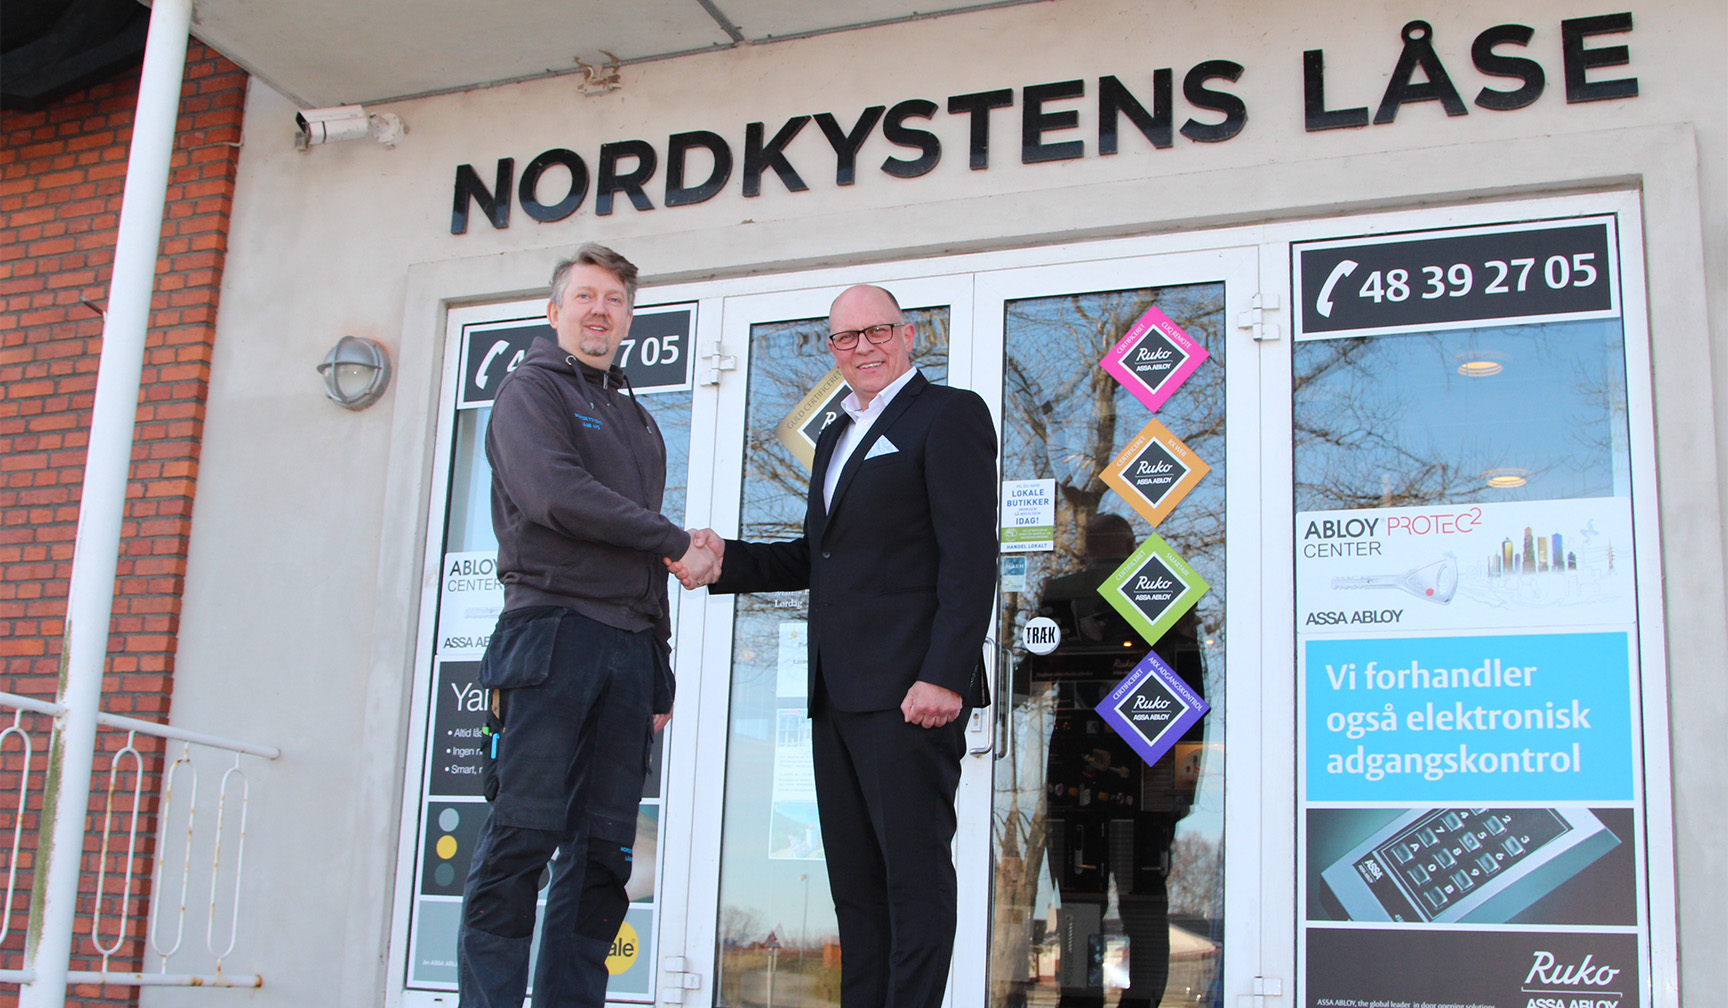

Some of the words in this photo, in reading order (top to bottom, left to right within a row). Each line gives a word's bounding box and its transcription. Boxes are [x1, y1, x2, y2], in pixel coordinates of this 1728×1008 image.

[450, 60, 1249, 235] NORDKYSTENS
[1302, 12, 1640, 132] LÅSE
[1359, 268, 1410, 304] 48
[1421, 263, 1474, 299] 39
[1485, 259, 1537, 295] 27
[1545, 253, 1598, 289] 05
[1116, 323, 1145, 354] CERTIFICERET
[1171, 330, 1192, 349] REMOTE
[506, 350, 525, 372] 4
[619, 339, 636, 368] 7
[640, 335, 680, 366] 05
[1136, 347, 1172, 361] Ruko
[1152, 363, 1171, 371] ABLOY
[803, 370, 842, 412] CERTIFICERET
[1116, 435, 1146, 467] CERTIFICERET
[1136, 460, 1173, 474] Ruko
[1012, 489, 1045, 497] LOKALE
[1007, 498, 1049, 507] BUTIKKER
[1015, 517, 1039, 525] IDAG!
[1303, 518, 1380, 540] ABLOY
[1303, 541, 1382, 558] CENTER
[1115, 550, 1146, 581] CERTIFICERET
[1135, 576, 1172, 590] Ruko
[774, 598, 803, 609] Lørdag
[1305, 611, 1348, 625] ASSA
[1350, 609, 1404, 624] ABLOY
[443, 637, 473, 648] ASSA
[1026, 627, 1056, 644] TRÆK
[1325, 663, 1356, 690] Vi
[1364, 658, 1537, 690] forhandler
[1112, 668, 1144, 700] CERTIFICERET
[1158, 666, 1203, 711] ADGANGSKONTROL
[1133, 695, 1171, 709] Ruko
[1326, 703, 1398, 739] også
[1406, 699, 1592, 731] elektronisk
[454, 729, 471, 737] Altid
[452, 747, 475, 758] Ingen
[1326, 742, 1581, 781] adgangskontrol
[1460, 811, 1469, 820] 4
[1502, 815, 1512, 823] 2
[1435, 826, 1445, 834] 7
[1478, 832, 1488, 840] 5
[1521, 836, 1530, 844] 3
[1410, 843, 1420, 852] A
[1453, 848, 1462, 856] 8
[1496, 852, 1504, 860] 6
[1365, 860, 1383, 880] ASSA
[608, 938, 634, 957] ale
[1524, 951, 1621, 986] Ruko
[1527, 998, 1564, 1008] ASSA
